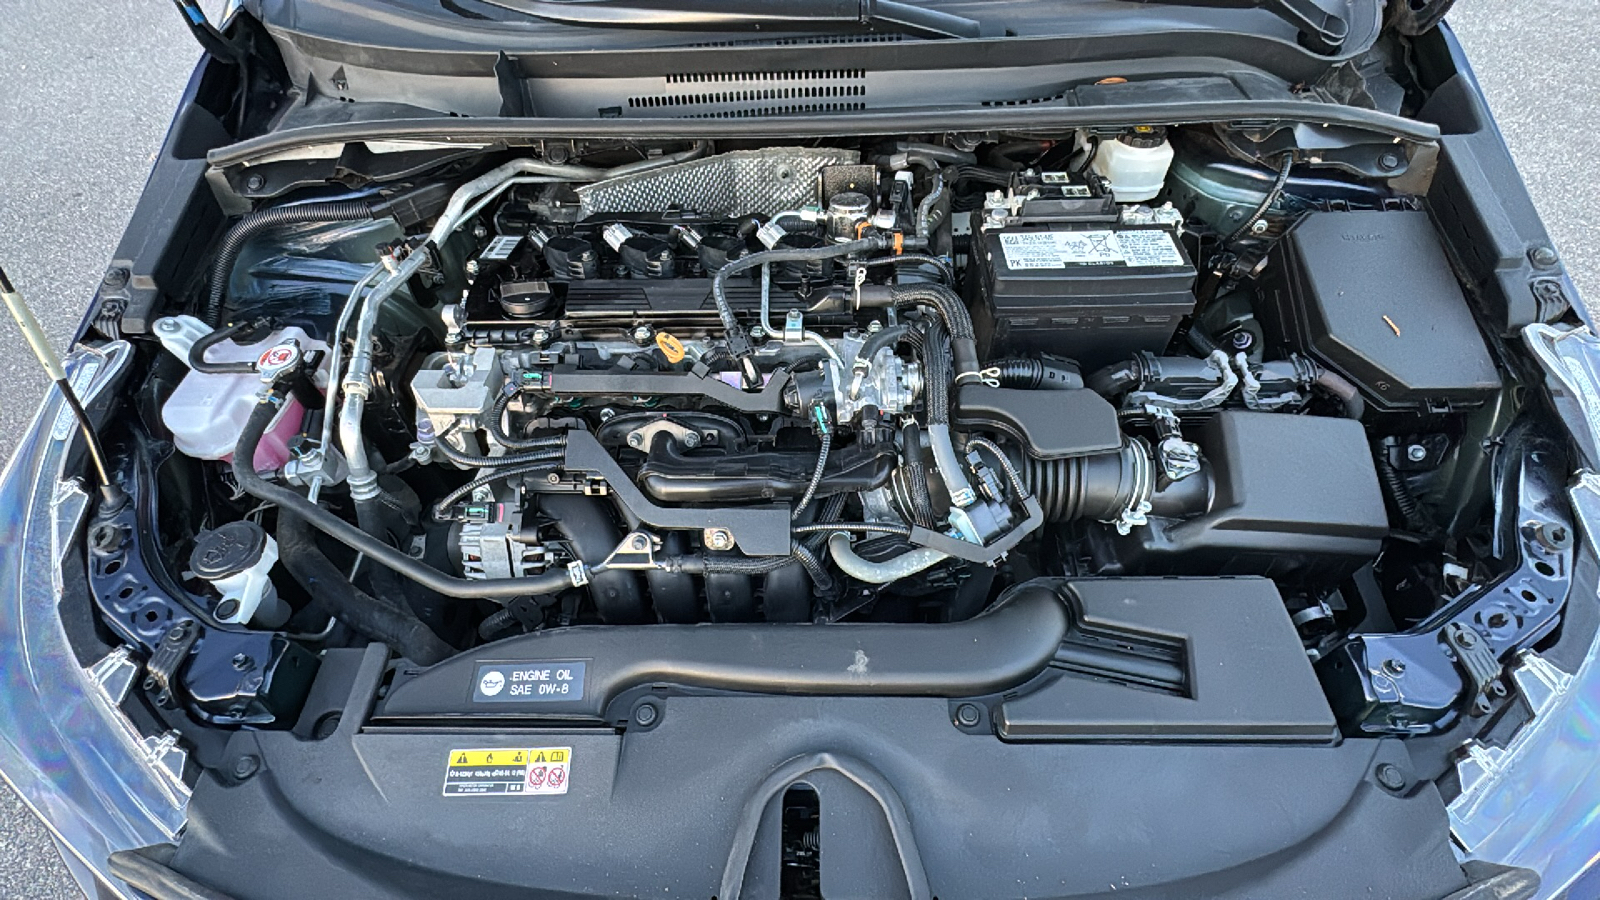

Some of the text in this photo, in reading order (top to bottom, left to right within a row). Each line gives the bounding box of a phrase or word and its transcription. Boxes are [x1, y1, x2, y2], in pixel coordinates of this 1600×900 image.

[1010, 259, 1021, 267] PK
[512, 669, 574, 681] ENGINE OIL
[509, 683, 569, 695] SAE 0W-8
